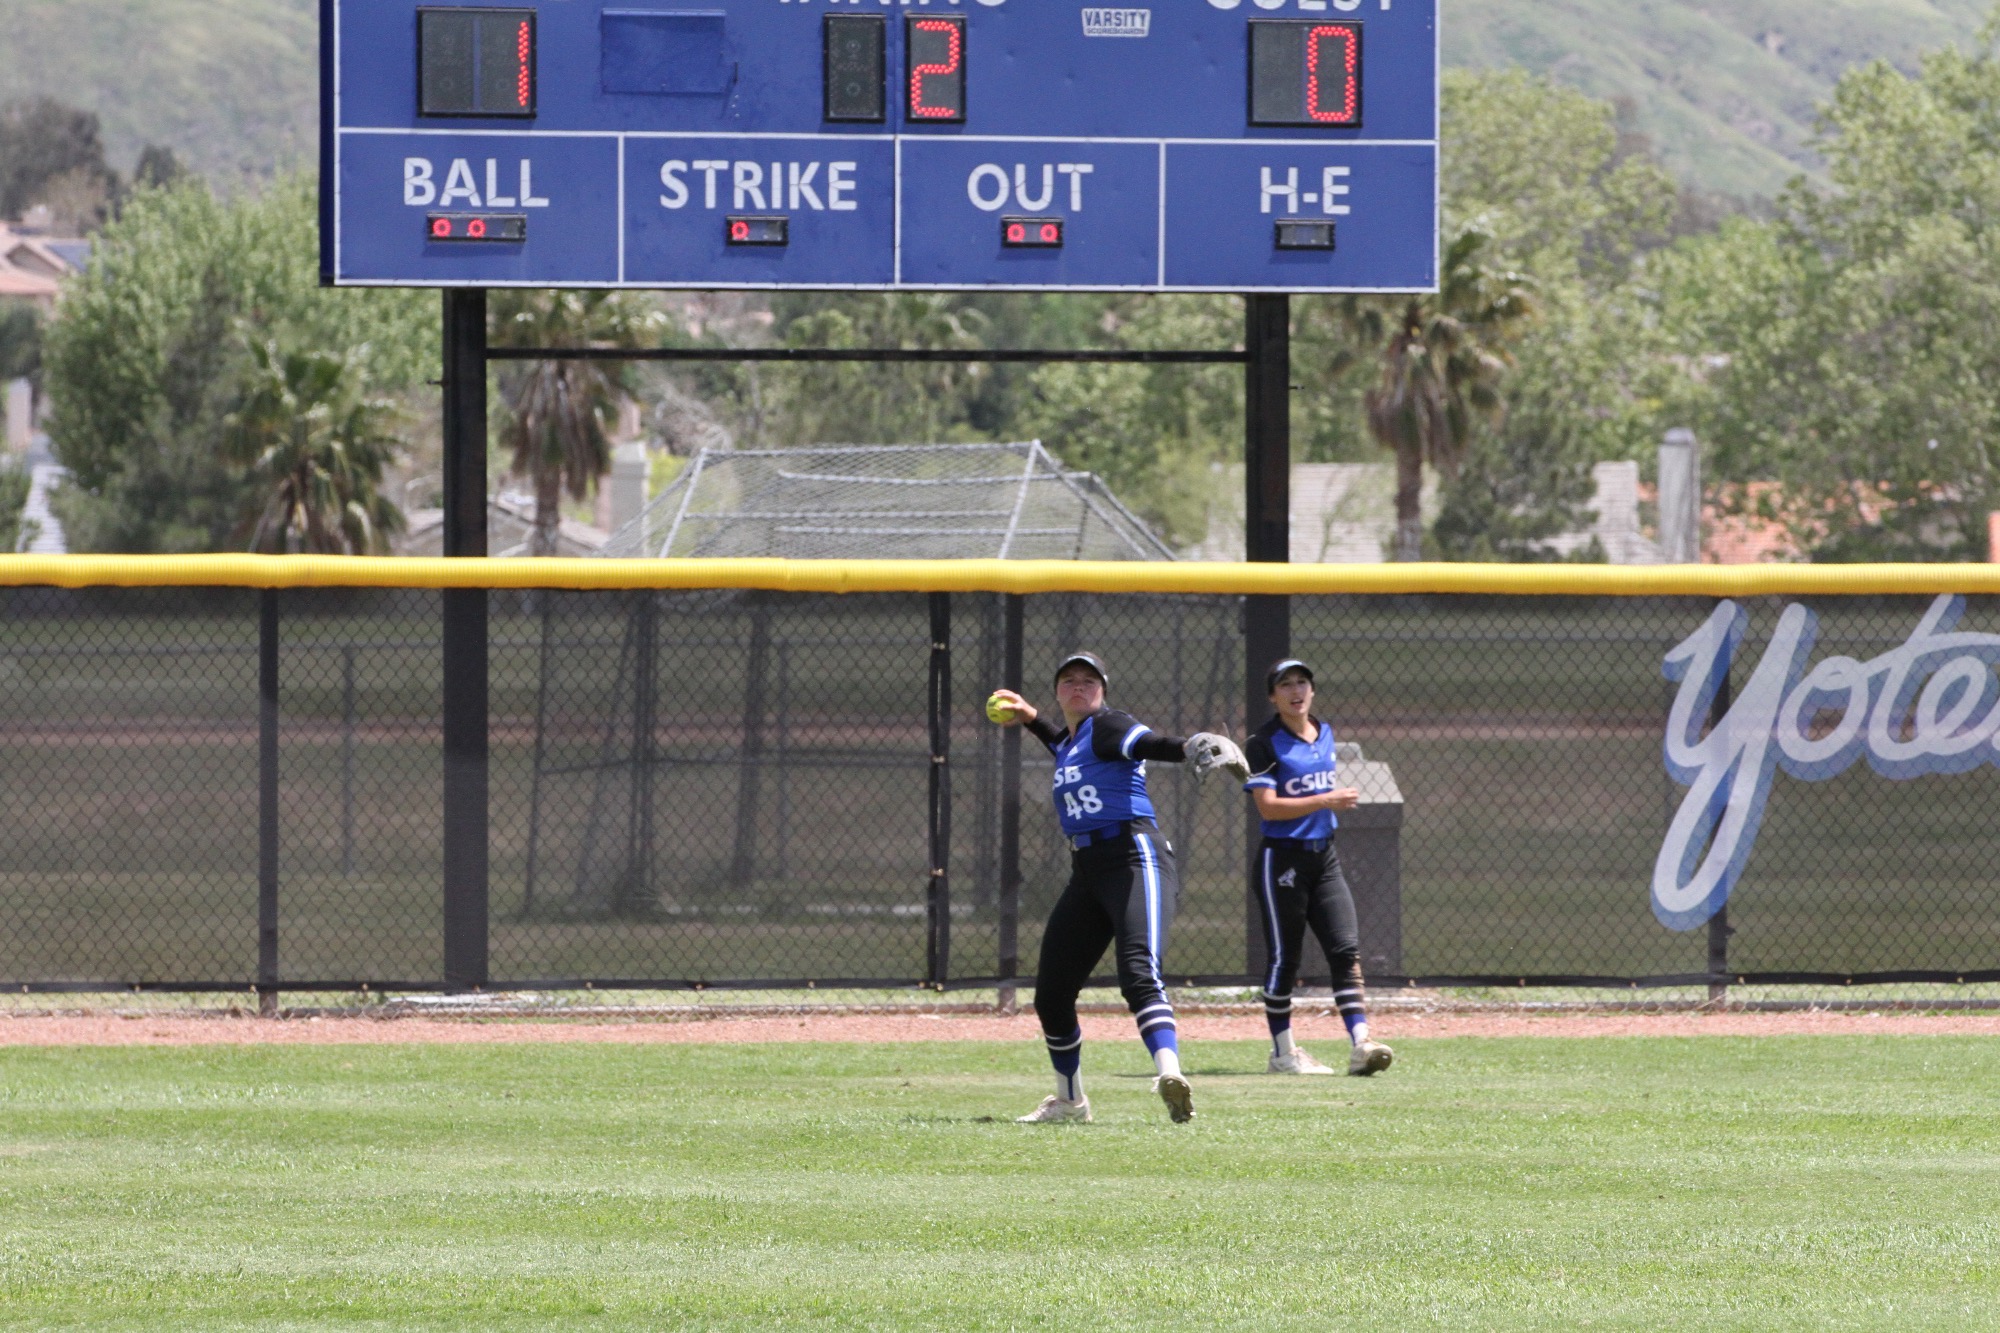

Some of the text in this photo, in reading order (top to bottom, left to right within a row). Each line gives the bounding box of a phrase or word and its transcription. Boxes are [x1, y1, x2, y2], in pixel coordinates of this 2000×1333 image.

[1084, 11, 1147, 27] VARSITY
[911, 20, 960, 118] 2
[1306, 26, 1356, 122] 0
[403, 157, 549, 207] BALL
[660, 159, 858, 210] STRIKE
[967, 163, 1094, 211] OUT
[1260, 166, 1351, 214] H-E
[1052, 766, 1082, 790] SB
[1651, 593, 2000, 931] Yote
[1063, 784, 1103, 820] 48
